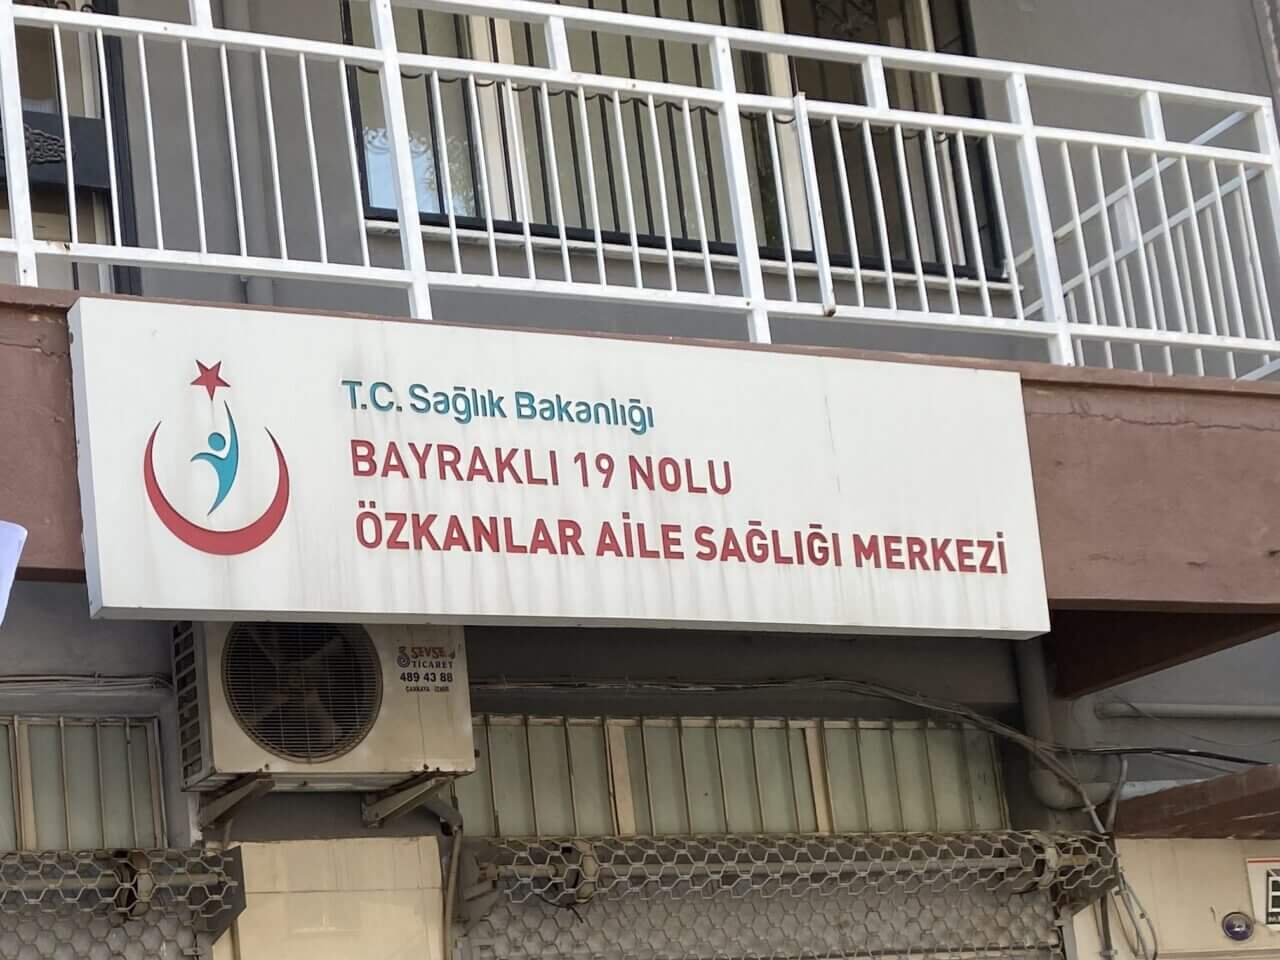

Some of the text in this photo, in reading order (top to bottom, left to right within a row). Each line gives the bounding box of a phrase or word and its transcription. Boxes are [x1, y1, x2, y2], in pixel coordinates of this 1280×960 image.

[341, 379, 655, 436] T.C. Sağlık Bakanlığı
[350, 439, 732, 495] BAYRAKLI 19 NOLU
[355, 500, 1008, 575] ÖZKANLAR AİLE SAĞLIĞI MERKEZİ
[400, 672, 420, 682] 489
[423, 672, 437, 682] 43
